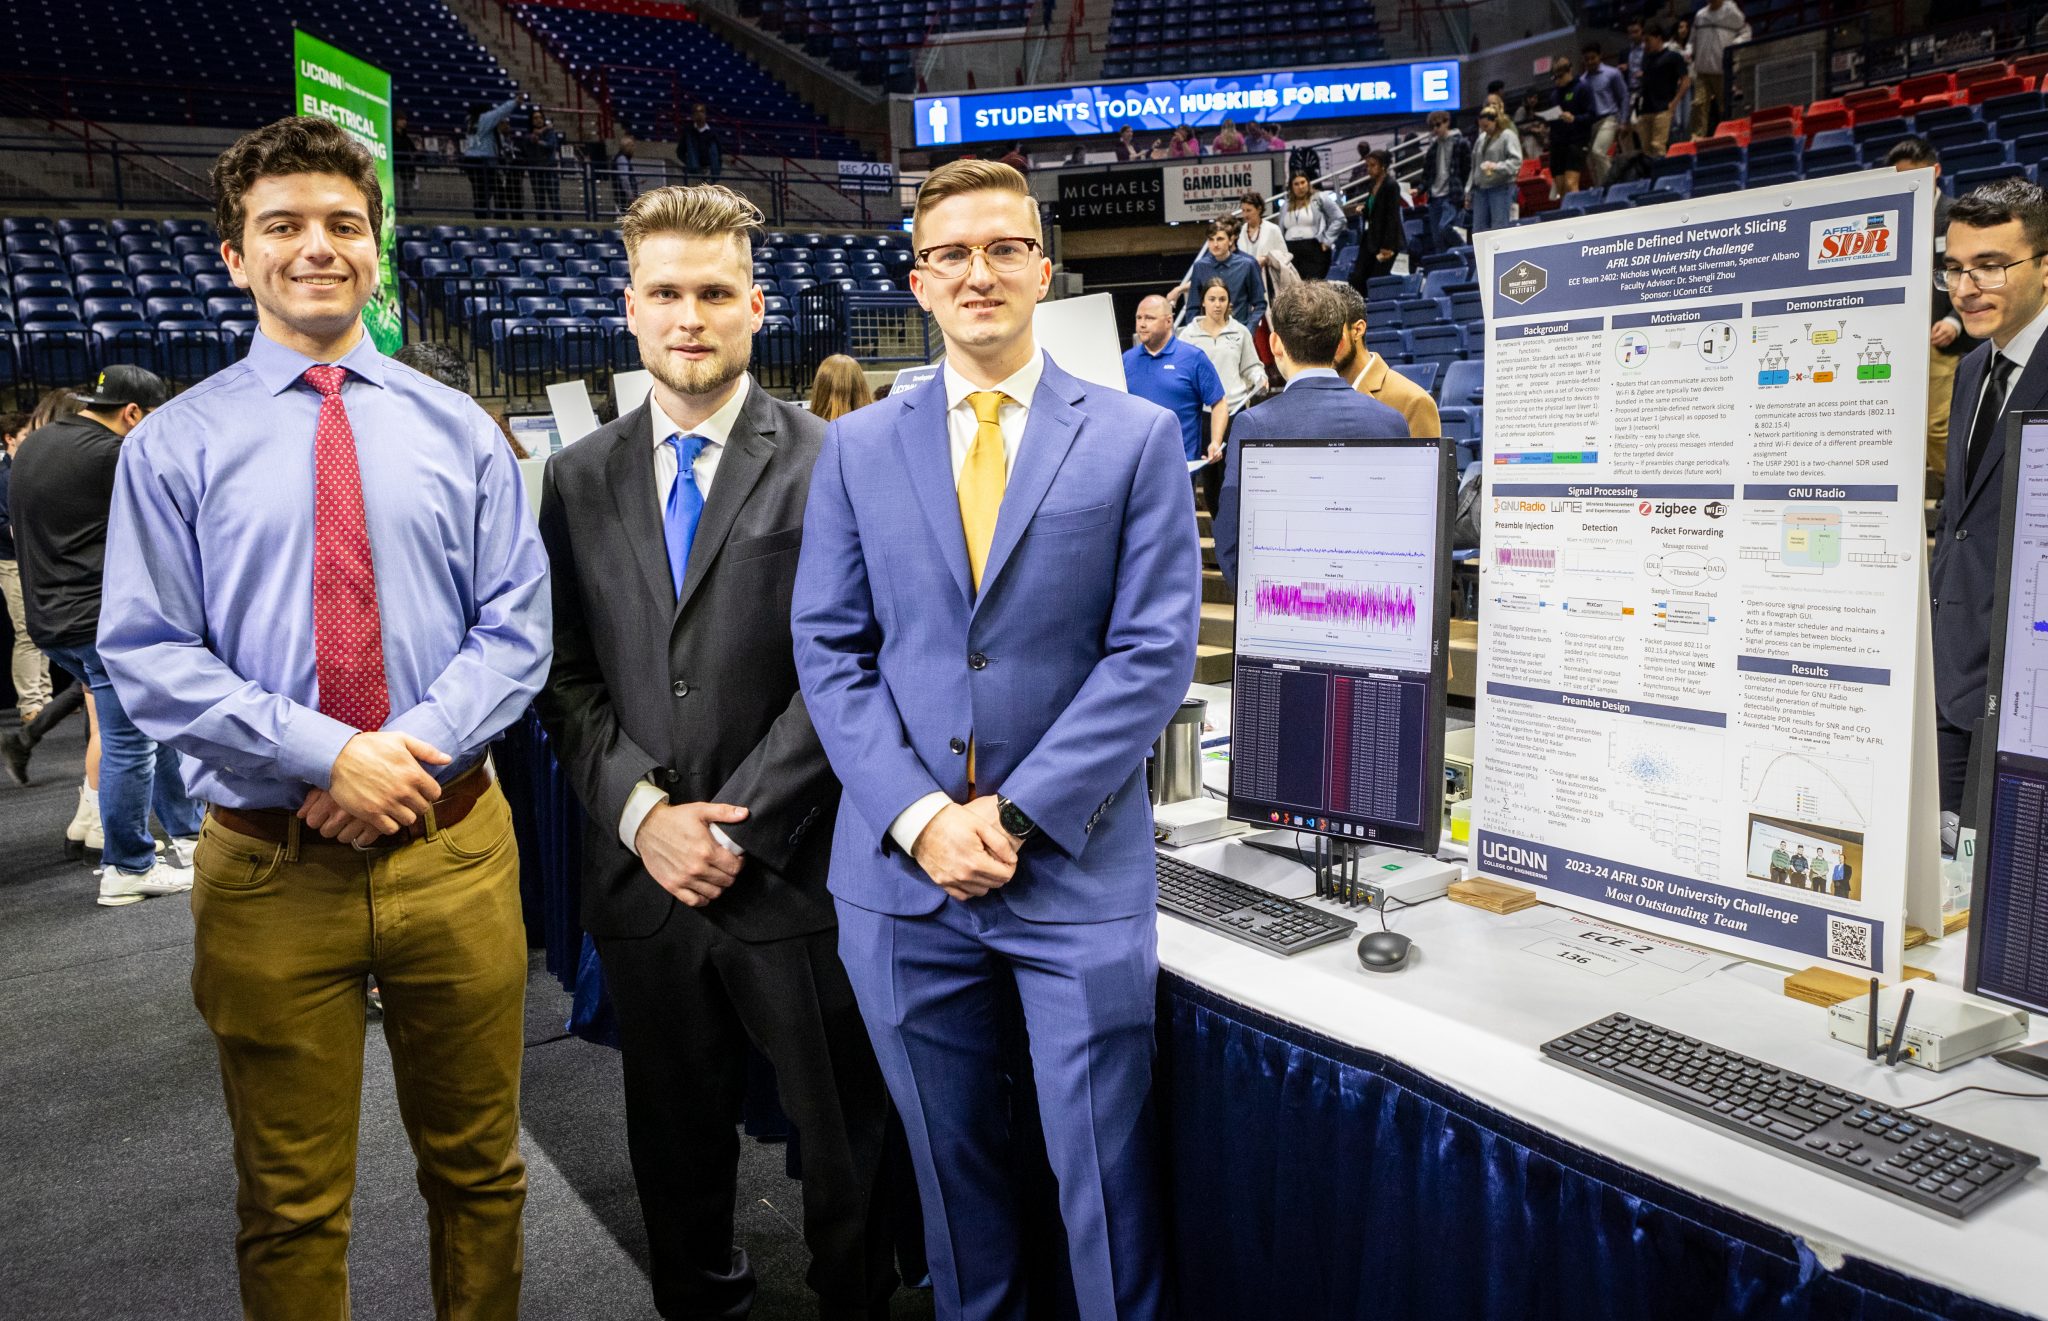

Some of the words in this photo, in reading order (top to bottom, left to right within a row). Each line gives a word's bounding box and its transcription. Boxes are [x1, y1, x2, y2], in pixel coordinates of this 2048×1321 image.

[301, 59, 342, 90] UCONN
[1422, 70, 1448, 101] E
[976, 103, 1089, 127] STUDENTS
[1096, 96, 1174, 118] TODAY.
[1180, 92, 1278, 116] HUSKIES
[1283, 84, 1397, 109] FOREVER.
[303, 94, 378, 138] ELECTRICAL
[840, 164, 857, 173] SEC
[862, 163, 891, 176] 205
[1183, 164, 1252, 176] PROBLEM
[1065, 180, 1160, 198] MICHAELS
[1184, 173, 1252, 191] GAMBLING
[1070, 200, 1156, 217] JEWELERS
[1581, 238, 1634, 257] Preamble
[1637, 232, 1684, 250] Defined
[1687, 224, 1741, 243] Network
[1745, 218, 1787, 234] Slicing
[1822, 225, 1856, 236] AFRL
[1818, 229, 1889, 259] SDR
[1606, 258, 1629, 270] AFRL
[1631, 255, 1650, 266] SDR
[1652, 248, 1701, 264] University
[1704, 242, 1754, 257] Challenge
[1853, 252, 1890, 260] CHALLENGE
[1568, 278, 1580, 286] ECE
[1581, 276, 1599, 285] Team
[1600, 272, 1619, 282] 2402:
[1620, 269, 1649, 280] Nicholas
[1651, 265, 1678, 278] Wycoff,
[1679, 263, 1696, 272] Matt
[1698, 259, 1737, 271] Silverman,
[1739, 256, 1769, 267] Spencer
[1772, 251, 1800, 261] Albano
[1620, 281, 1645, 291] Faculty
[1647, 277, 1675, 288] Advisor:
[1677, 277, 1687, 285] Dr.
[1688, 272, 1715, 284] Shengli
[1716, 271, 1736, 280] Zhou
[1640, 291, 1671, 300] Sponsor:
[1673, 288, 1697, 297] UConn
[1699, 285, 1712, 294] ECE
[1787, 296, 1864, 312] Demonstration
[1651, 311, 1700, 324] Motivation
[1524, 323, 1569, 336] Background
[1840, 400, 1857, 408] point
[1782, 430, 1817, 438] partitioning
[1859, 439, 1893, 447] preamble
[1568, 486, 1592, 497] Signal
[1594, 487, 1638, 497] Processing
[1788, 488, 1812, 498] GNU
[1815, 488, 1846, 498] Radio
[1655, 502, 1696, 518] zigbee
[1495, 521, 1523, 529] Preamble
[1525, 523, 1554, 531] Injection
[1582, 524, 1617, 532] Detection
[1651, 527, 1676, 535] Packet
[1679, 527, 1724, 538] Forwarding
[1792, 664, 1829, 677] Results
[1562, 695, 1601, 707] Preamble
[1602, 701, 1630, 713] Design
[1743, 721, 1770, 730] Awarded
[1792, 727, 1831, 739] Outstanding
[1856, 736, 1864, 744] by
[1482, 840, 1547, 872] UCONN
[1483, 860, 1506, 870] COLLEGE
[1514, 868, 1548, 880] ENGINEERING
[1565, 858, 1609, 879] 2023-24
[1611, 870, 1638, 887] AFRL
[1640, 876, 1664, 892] SDR
[1667, 883, 1730, 907] University
[1733, 898, 1798, 924] Challenge
[1605, 886, 1632, 901] Most
[1635, 893, 1710, 924] Outstanding
[1713, 912, 1748, 932] Team
[1578, 931, 1632, 947] ECE
[1630, 945, 1654, 954] 2
[1556, 951, 1591, 964] 136
